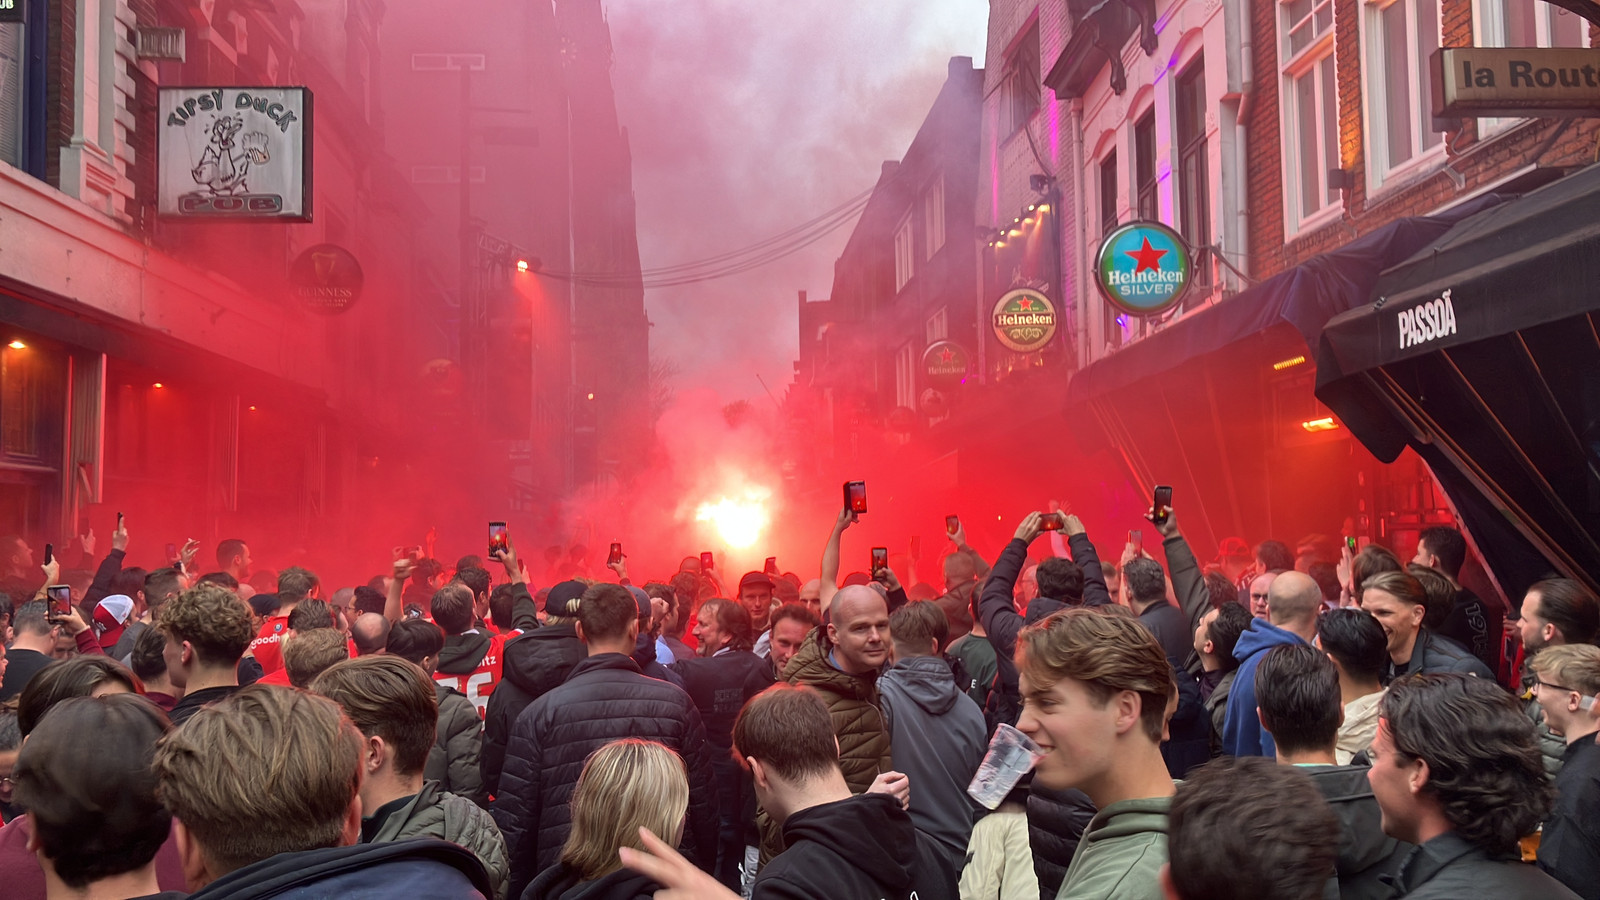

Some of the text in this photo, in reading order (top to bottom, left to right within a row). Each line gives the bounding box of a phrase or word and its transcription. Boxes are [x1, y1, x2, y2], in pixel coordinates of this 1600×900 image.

[1463, 61, 1600, 88] la Rout
[167, 88, 298, 133] TIPSY DUCK
[183, 197, 280, 211] PUB
[1108, 268, 1184, 286] Heineken
[298, 287, 352, 297] GUINNESS
[1120, 284, 1175, 296] SILVER
[997, 313, 1054, 326] Heineken
[1398, 288, 1457, 350] PASSOÃ
[928, 366, 966, 376] Heineken
